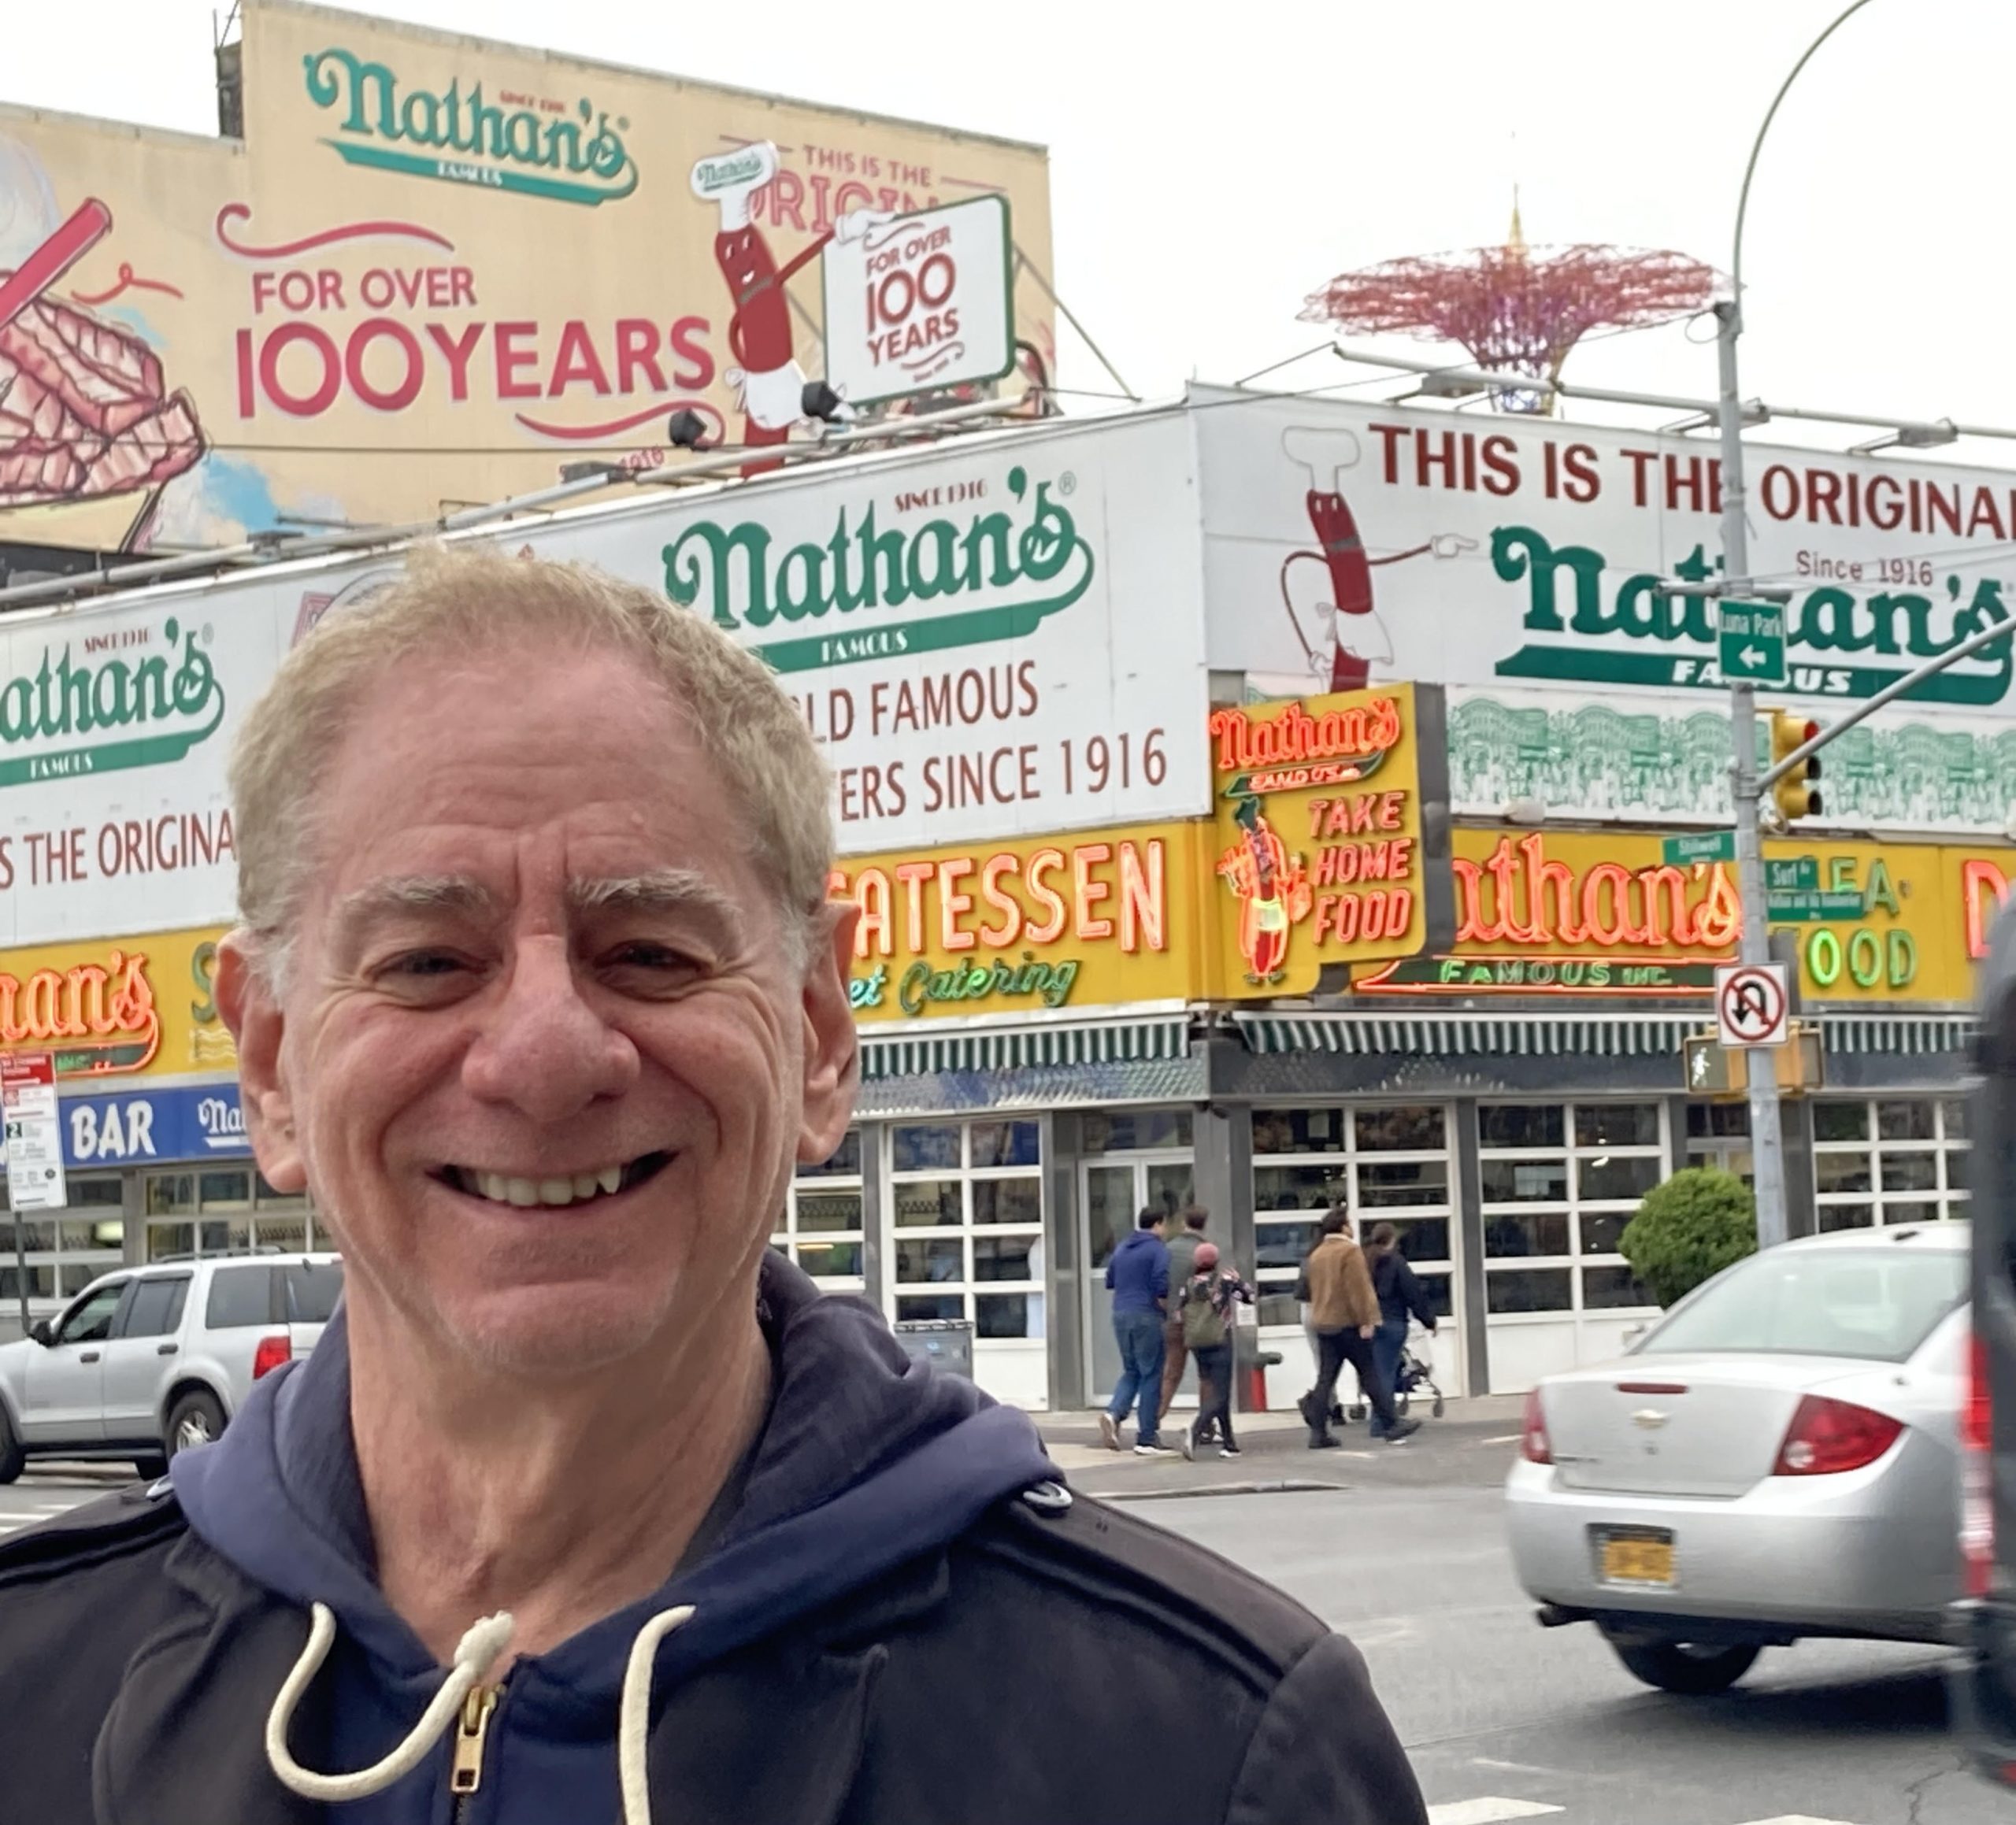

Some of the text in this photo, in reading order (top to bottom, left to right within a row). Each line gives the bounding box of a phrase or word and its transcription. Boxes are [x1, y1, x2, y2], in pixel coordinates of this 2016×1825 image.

[303, 47, 627, 180] Nathan's
[803, 144, 932, 187] THIS IS THE
[866, 225, 951, 279] FOR OVER
[252, 265, 478, 314] FOR OVER
[866, 252, 956, 335] 100
[866, 308, 959, 368] YEARS
[1368, 423, 1521, 497] THIS
[1544, 439, 1601, 504] IS
[895, 477, 989, 514] SINCE 1916
[662, 465, 1077, 629] Nathan's
[1796, 550, 1934, 587] Since 1916
[1490, 525, 2014, 663] Natan's
[821, 627, 909, 664] FAMOUS
[871, 660, 1039, 736] FAMOUS
[1671, 658, 1853, 694] FAUS
[1210, 698, 1401, 770] Nathan's
[30, 752, 94, 780] FAMOUS
[923, 745, 1040, 813] SINCE
[1060, 727, 1167, 796] 1916
[1308, 790, 1406, 838] TAKE
[24, 827, 88, 886] THE
[1313, 837, 1414, 887] HOME
[1313, 888, 1412, 946] FOOD
[899, 953, 1082, 1016] Catering
[1440, 958, 1611, 986] FAMOUS
[71, 1099, 157, 1160] BAR
